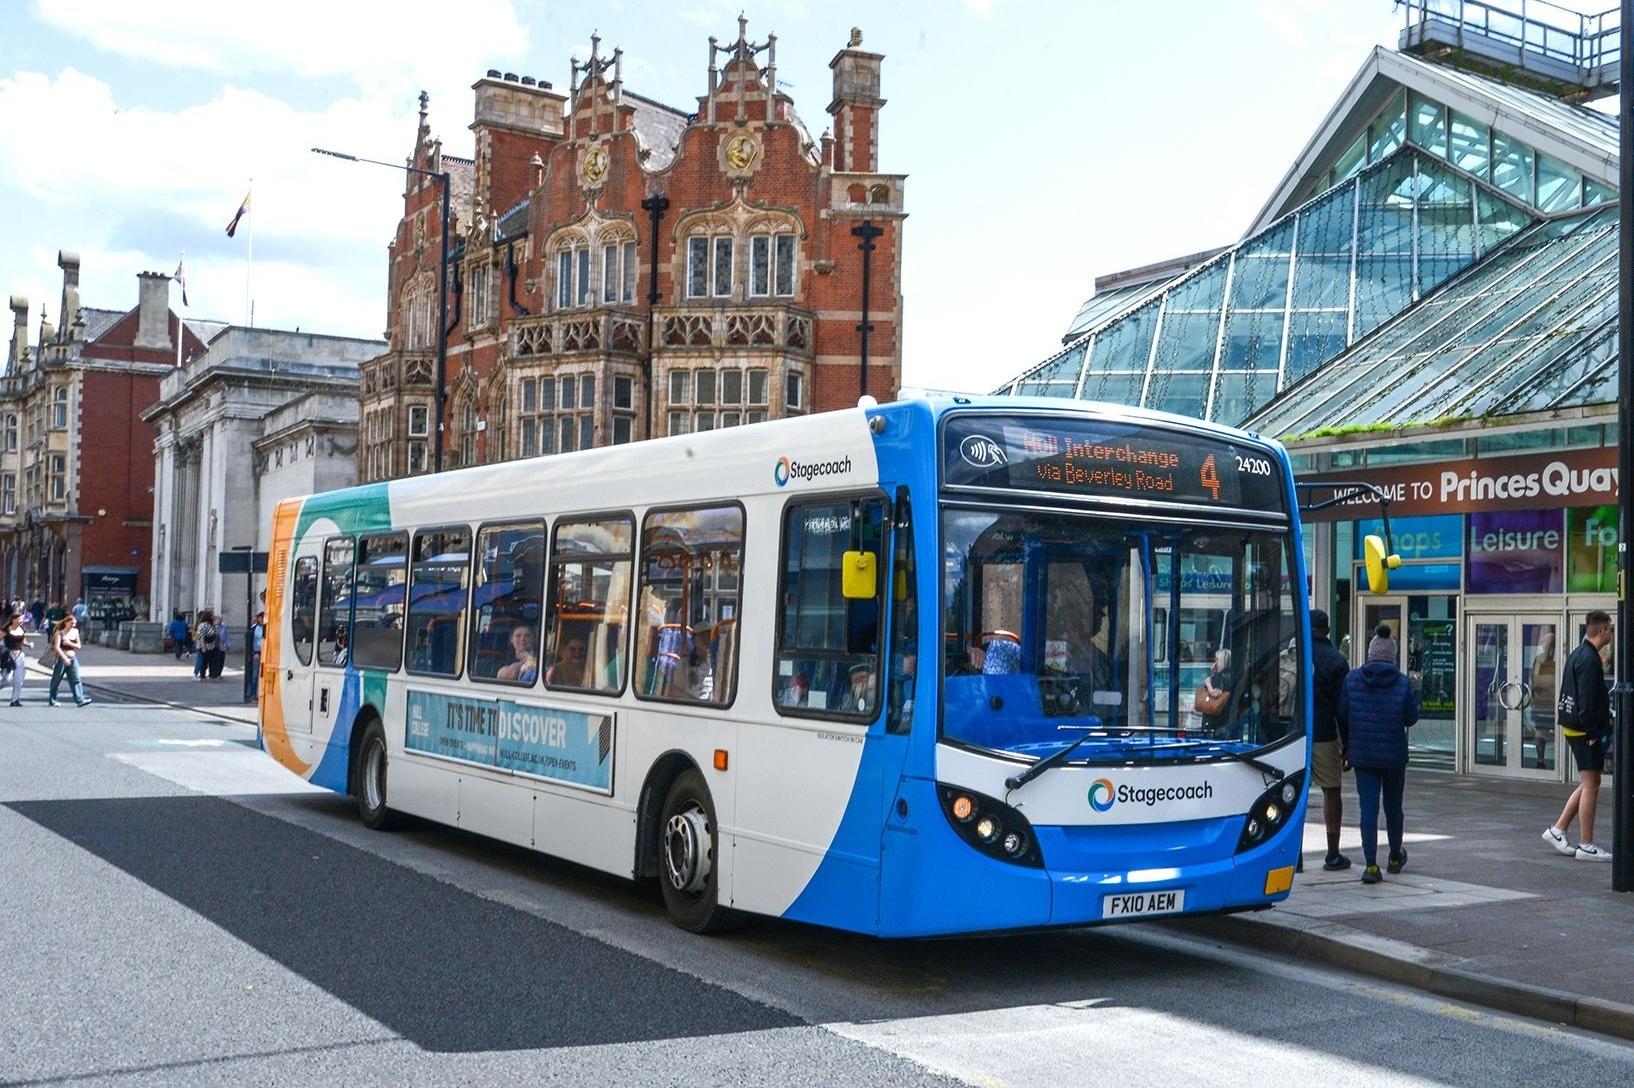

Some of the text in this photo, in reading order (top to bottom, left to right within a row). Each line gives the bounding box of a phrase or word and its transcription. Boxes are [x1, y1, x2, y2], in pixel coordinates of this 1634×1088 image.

[1065, 437, 1179, 468] Interchange
[1235, 456, 1271, 476] 24200
[790, 455, 852, 481] Stagecoach
[1037, 463, 1174, 491] via Beverley Road
[1200, 453, 1220, 500] 4
[1411, 481, 1433, 499] TO
[1470, 526, 1560, 552] Leisure
[447, 702, 464, 731] IT'S
[465, 705, 486, 735] TIME
[499, 711, 566, 749] DISCOVER
[1117, 780, 1213, 807] Stagecoach
[1111, 893, 1176, 914] FX10 AEM
